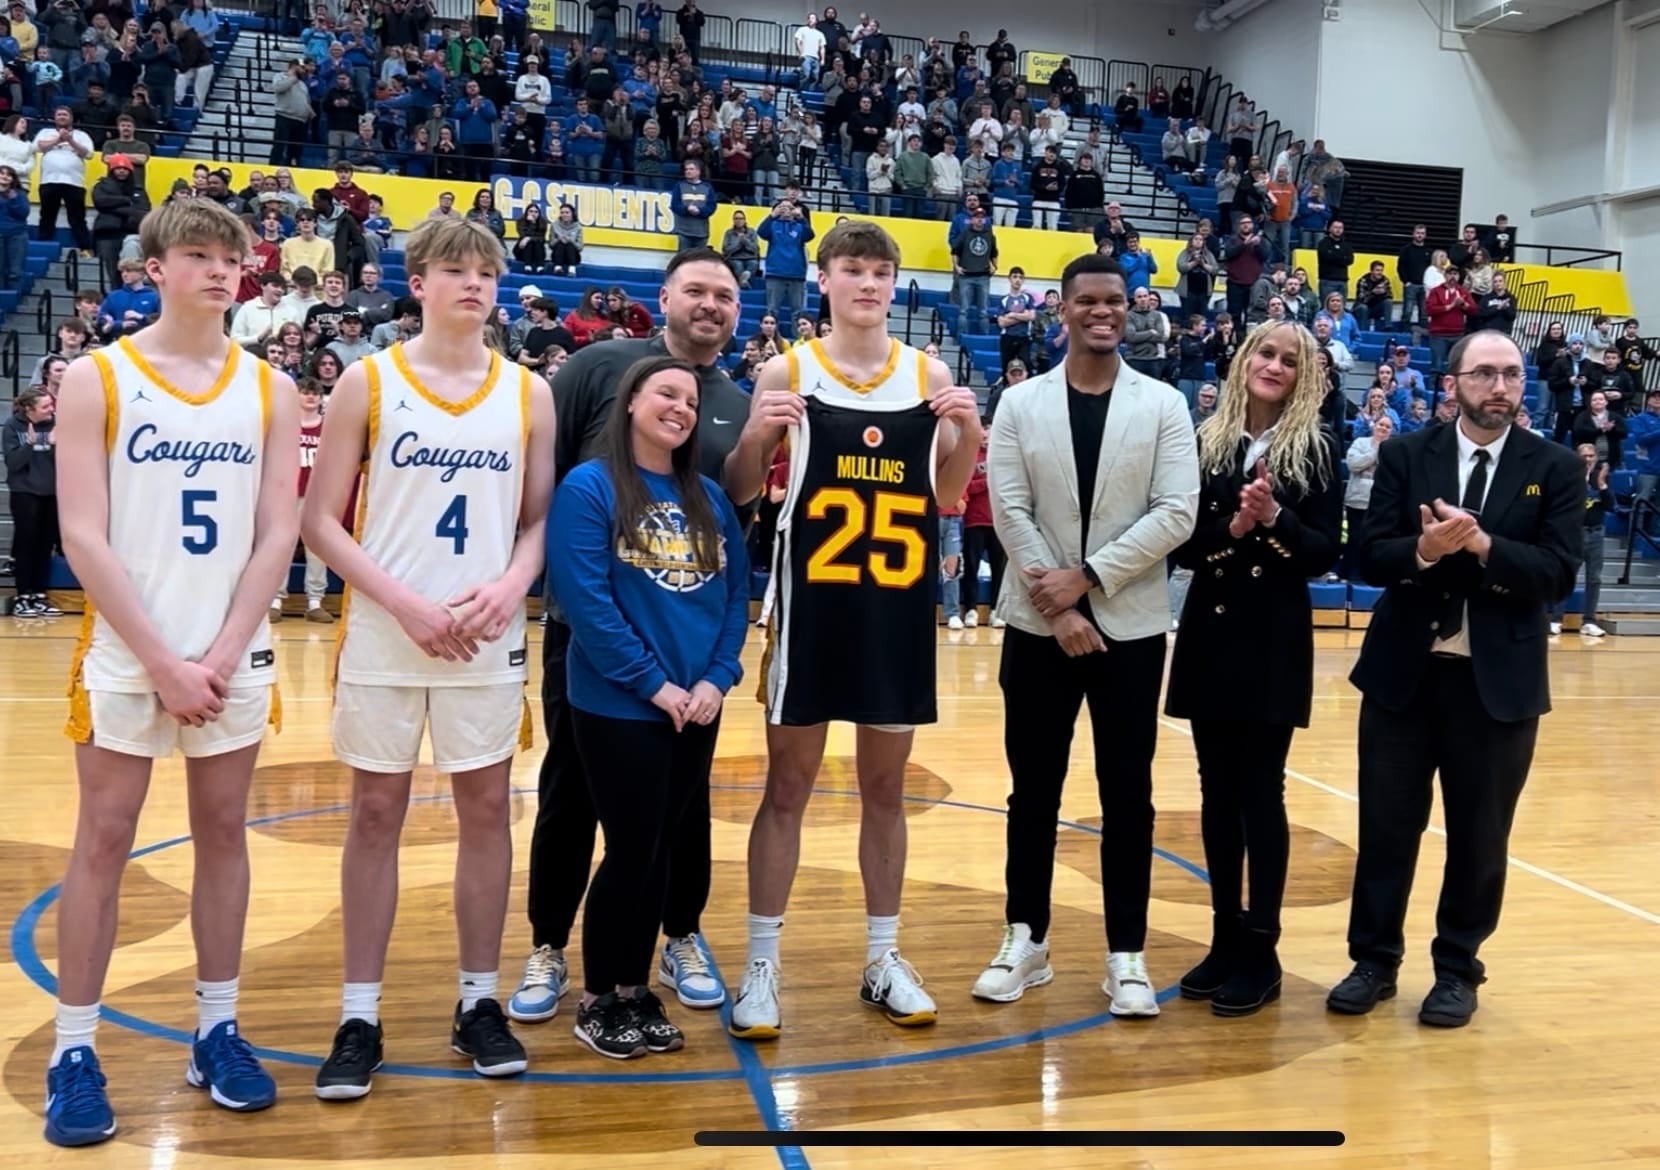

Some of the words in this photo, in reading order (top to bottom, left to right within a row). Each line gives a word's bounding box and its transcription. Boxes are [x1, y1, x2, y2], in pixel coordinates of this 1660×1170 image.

[545, 182, 675, 233] STUDENTS
[127, 423, 256, 478] Cougars
[391, 431, 512, 483] Cougars
[837, 455, 905, 484] MULLINS
[182, 490, 217, 555] 5
[435, 494, 468, 555] 4
[807, 487, 928, 590] 25
